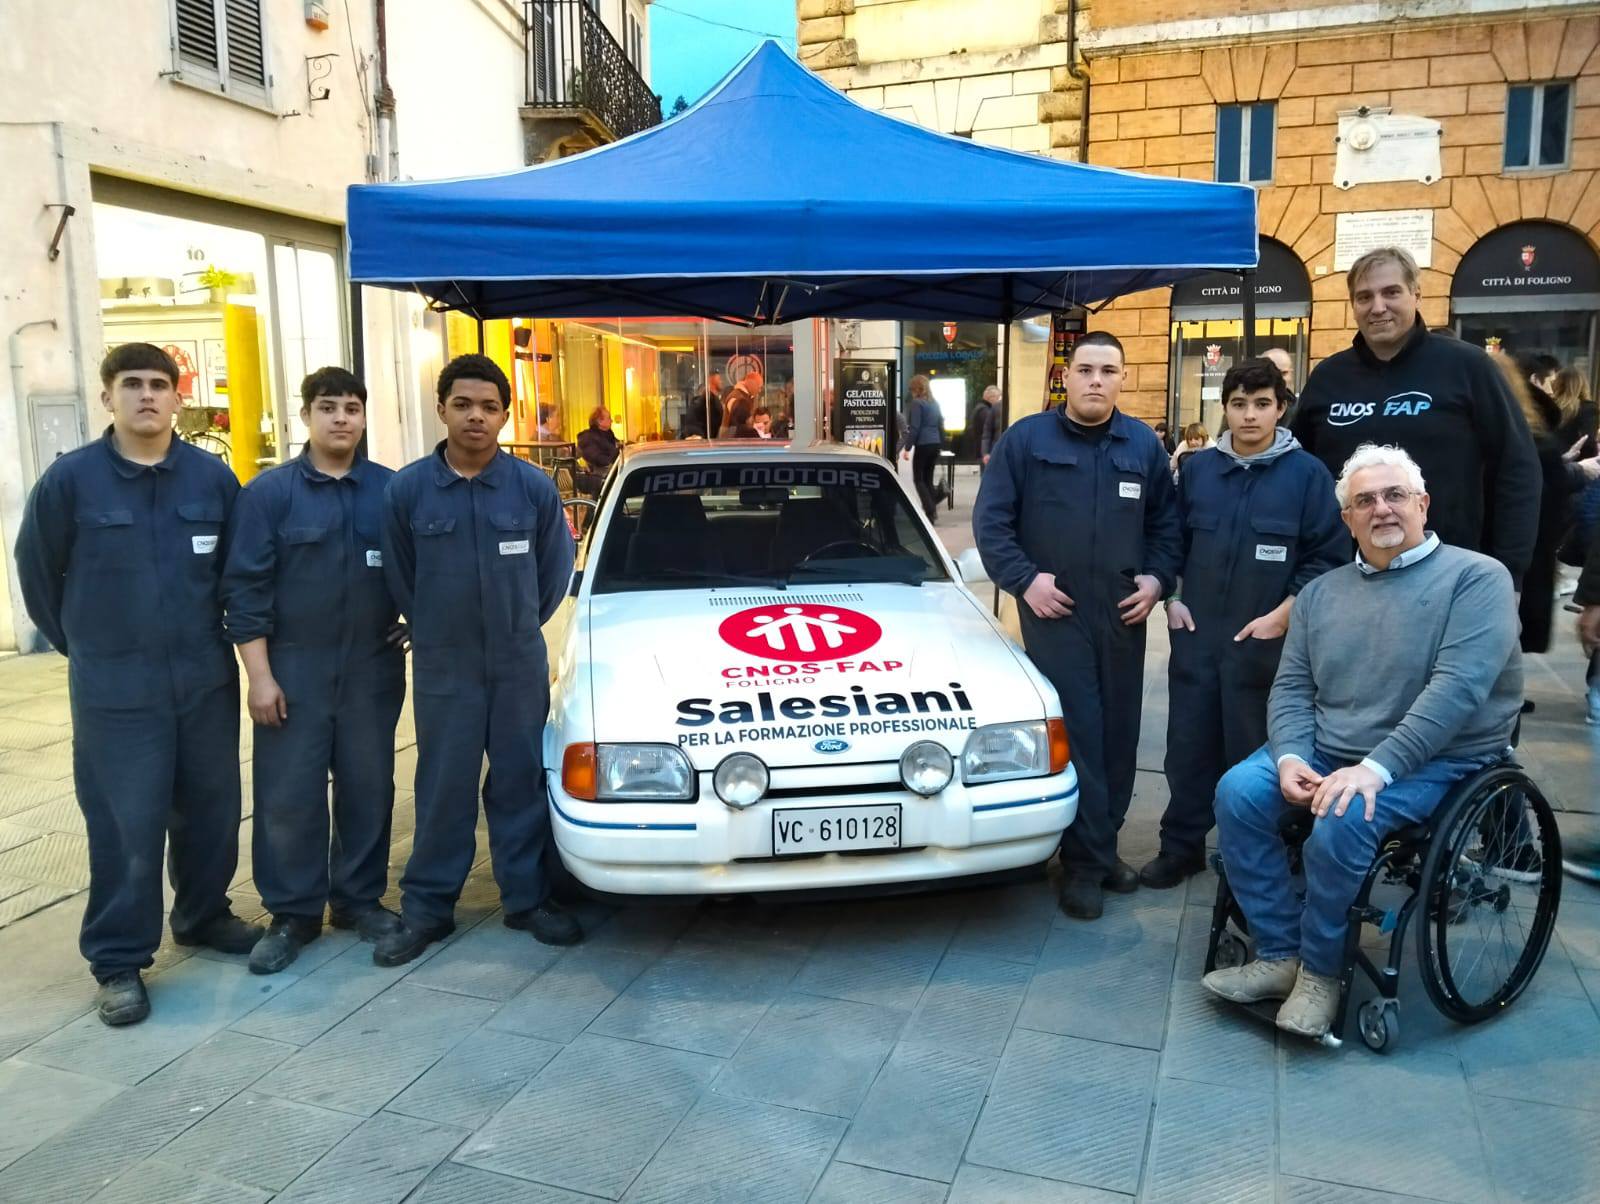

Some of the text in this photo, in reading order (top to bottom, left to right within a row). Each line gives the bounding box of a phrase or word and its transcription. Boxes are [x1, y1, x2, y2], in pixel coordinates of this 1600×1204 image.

[1482, 275, 1572, 287] CITTÀ DI FOLIGNO
[1201, 285, 1282, 296] CITTÀ DI LIGNO
[846, 389, 884, 398] GELATERIA
[843, 399, 887, 407] PASTICCERIA
[1329, 400, 1432, 418] CNOS FAP
[643, 467, 881, 493] IRON MOTORS
[720, 660, 904, 679] CNOS-FAP
[725, 676, 816, 688] FOLIGNO
[675, 682, 974, 727] Salesiani
[677, 716, 978, 747] PER LA FORMAZIONE PROFESSIONALE
[820, 740, 842, 750] Ford
[779, 815, 897, 843] VC 610128
